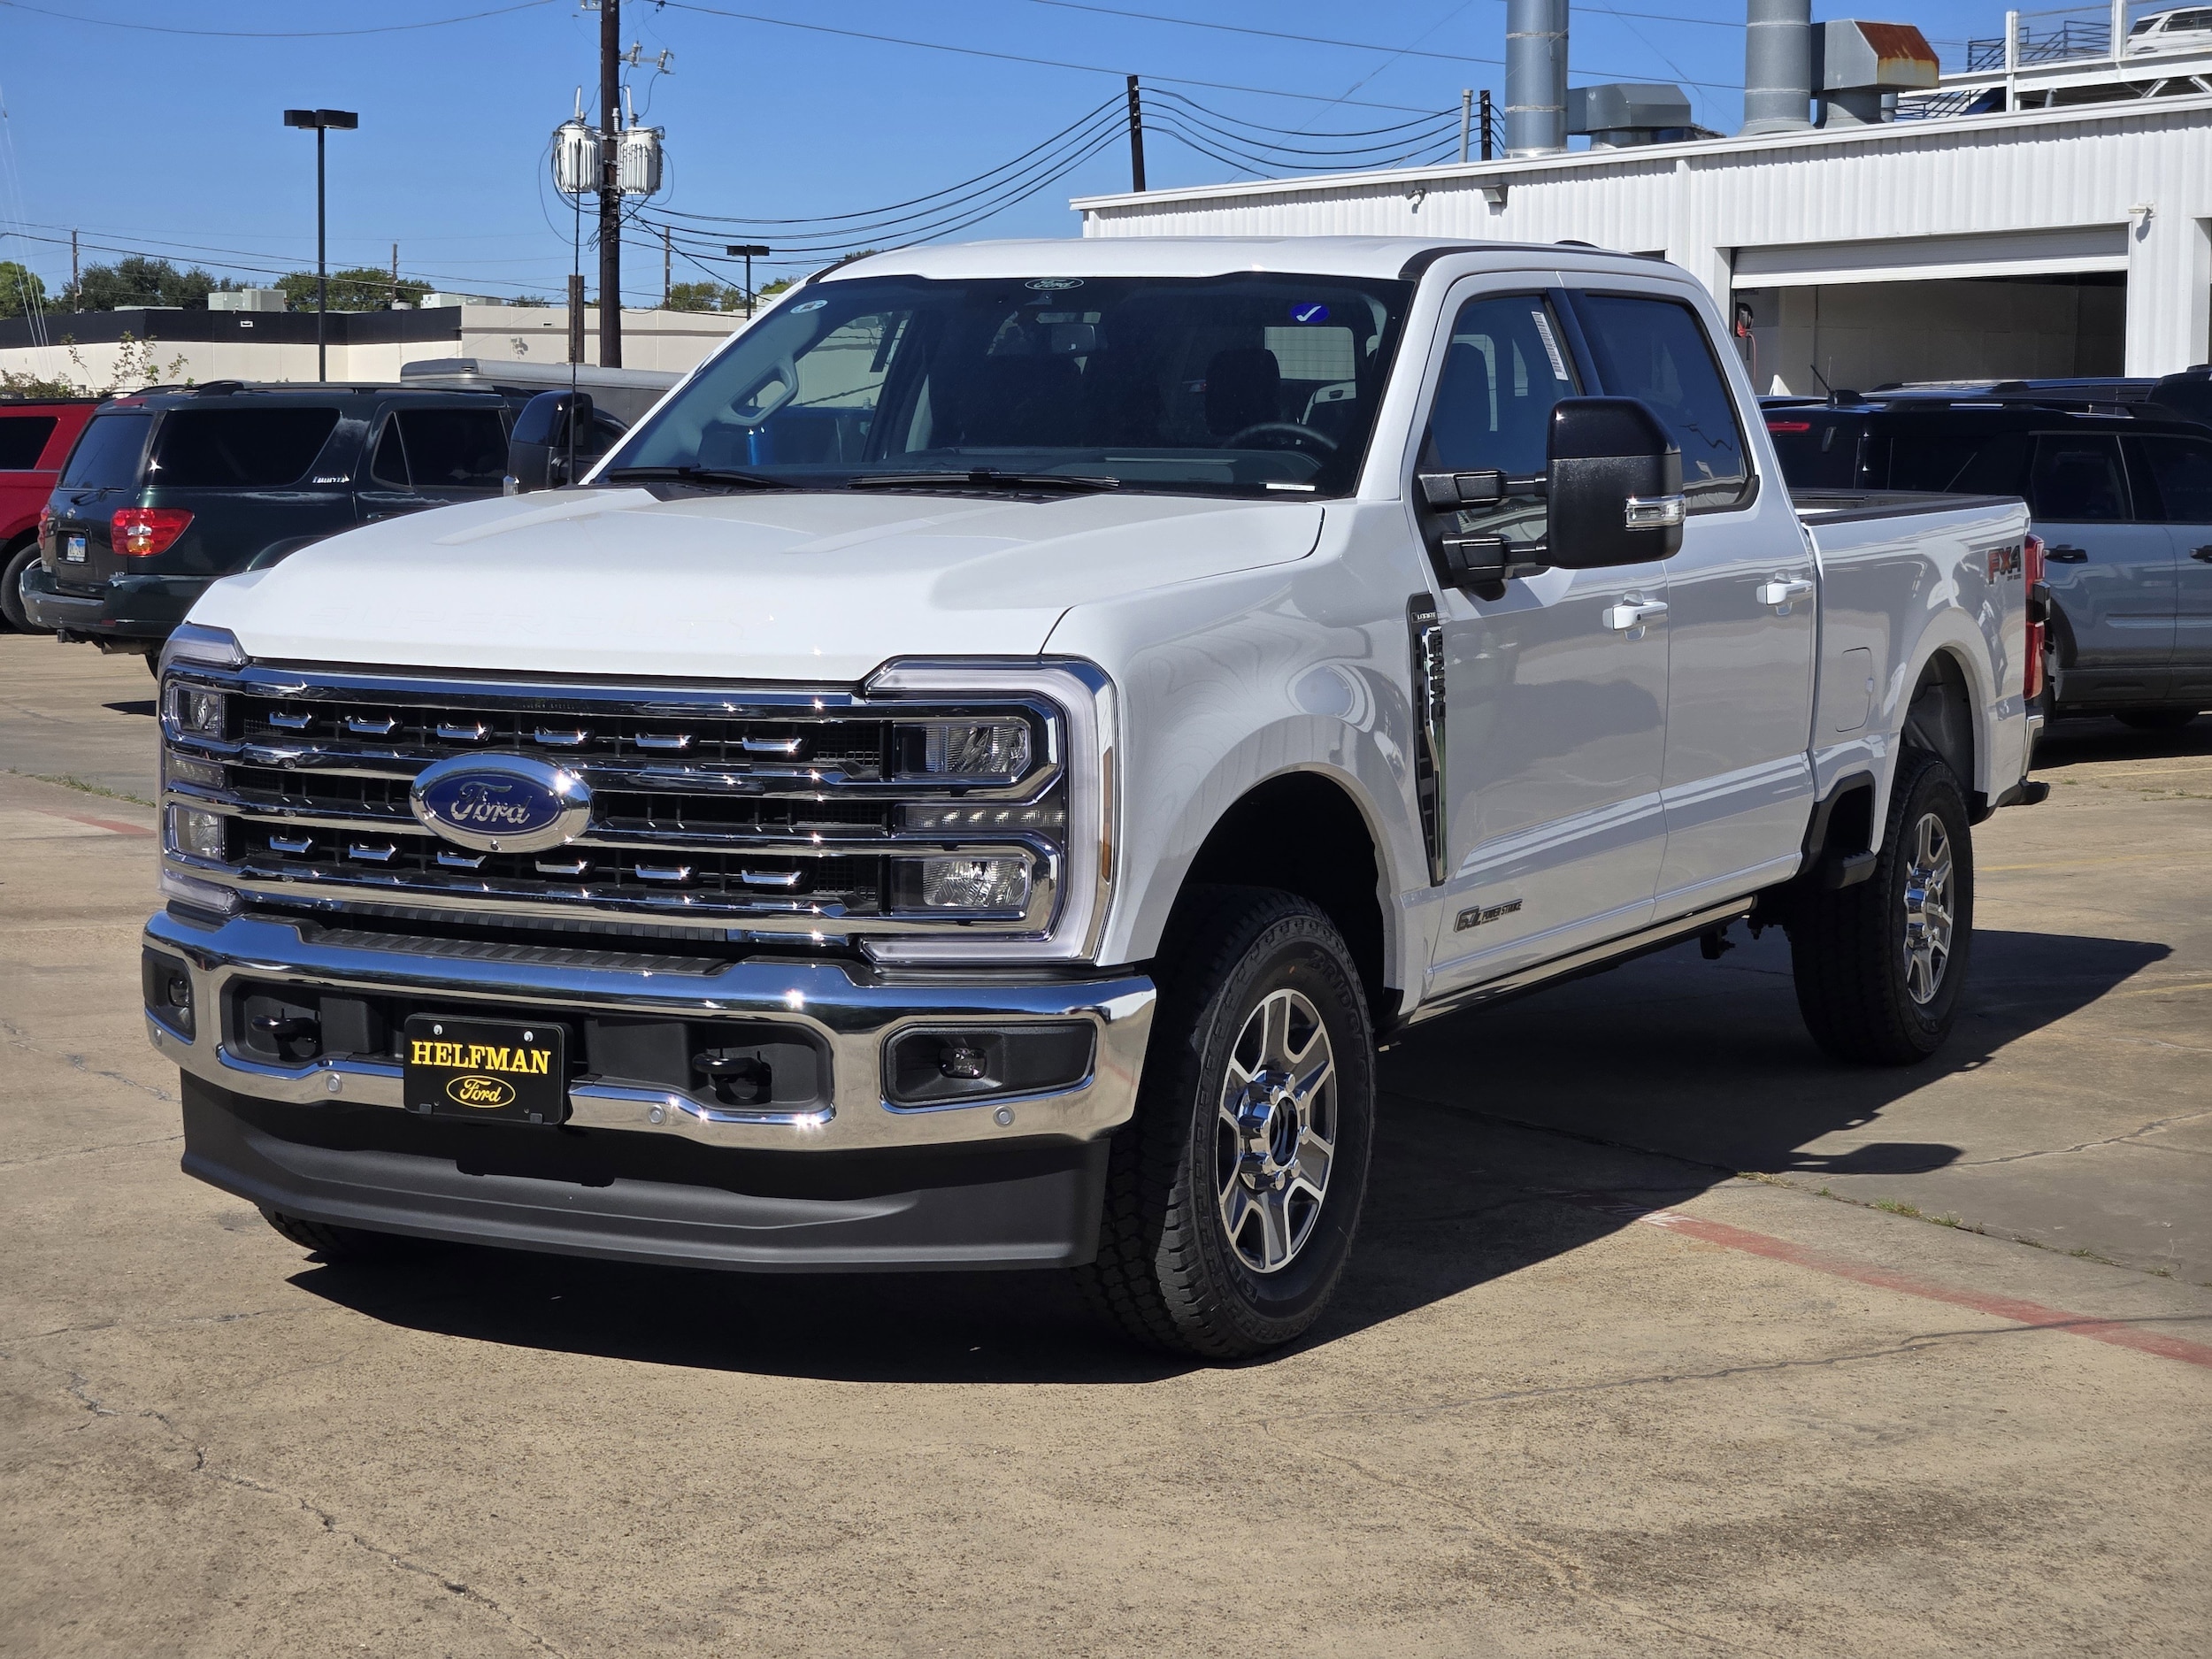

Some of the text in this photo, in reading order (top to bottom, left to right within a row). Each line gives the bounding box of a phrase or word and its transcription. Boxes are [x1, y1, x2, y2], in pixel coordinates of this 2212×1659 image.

[1033, 279, 1075, 288] Ford
[1987, 544, 2022, 585] FX4
[449, 781, 533, 825] Ford
[411, 1040, 552, 1075] HELFMAN
[458, 1078, 502, 1103] Ford
